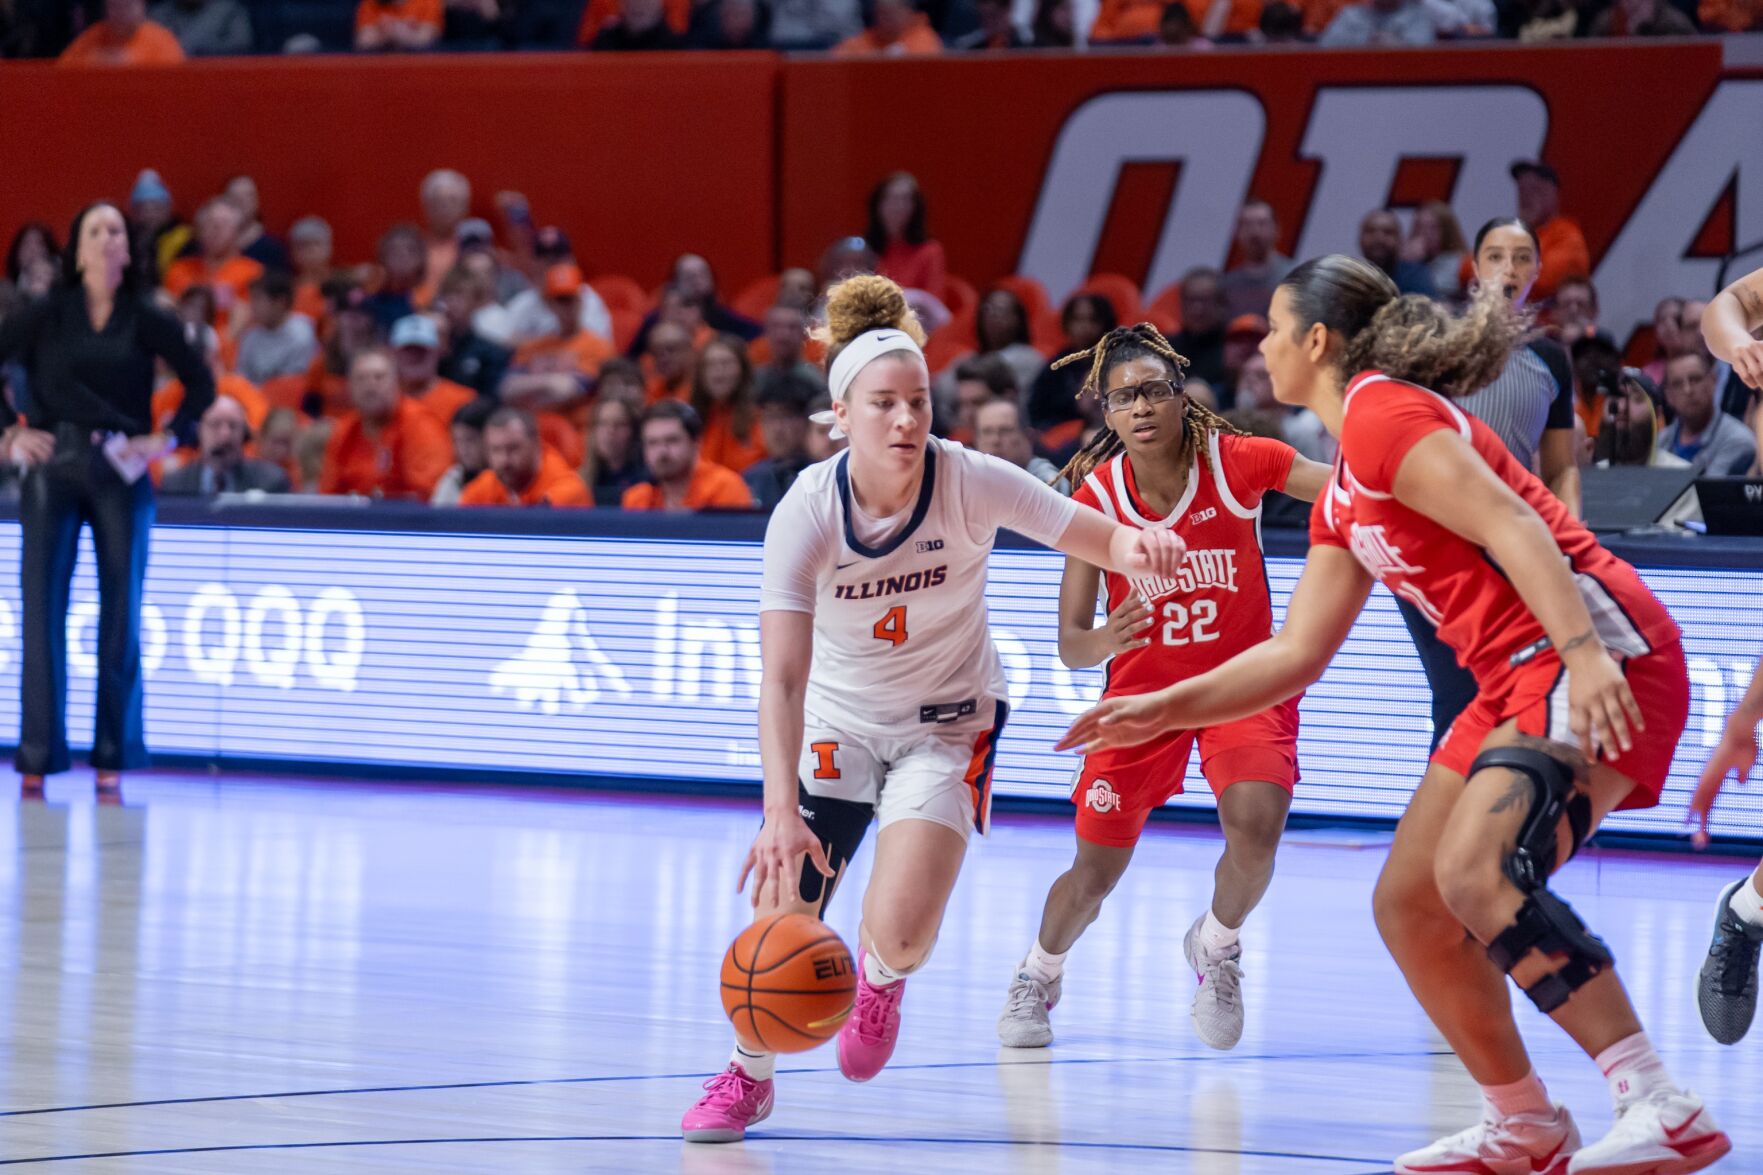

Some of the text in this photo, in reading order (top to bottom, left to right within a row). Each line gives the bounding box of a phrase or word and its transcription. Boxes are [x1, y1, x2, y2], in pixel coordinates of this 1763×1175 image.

[835, 564, 947, 600] ILLINOIS
[183, 582, 366, 692] QQQ
[873, 605, 908, 647] 4
[1162, 598, 1221, 646] 22
[811, 741, 841, 779] I
